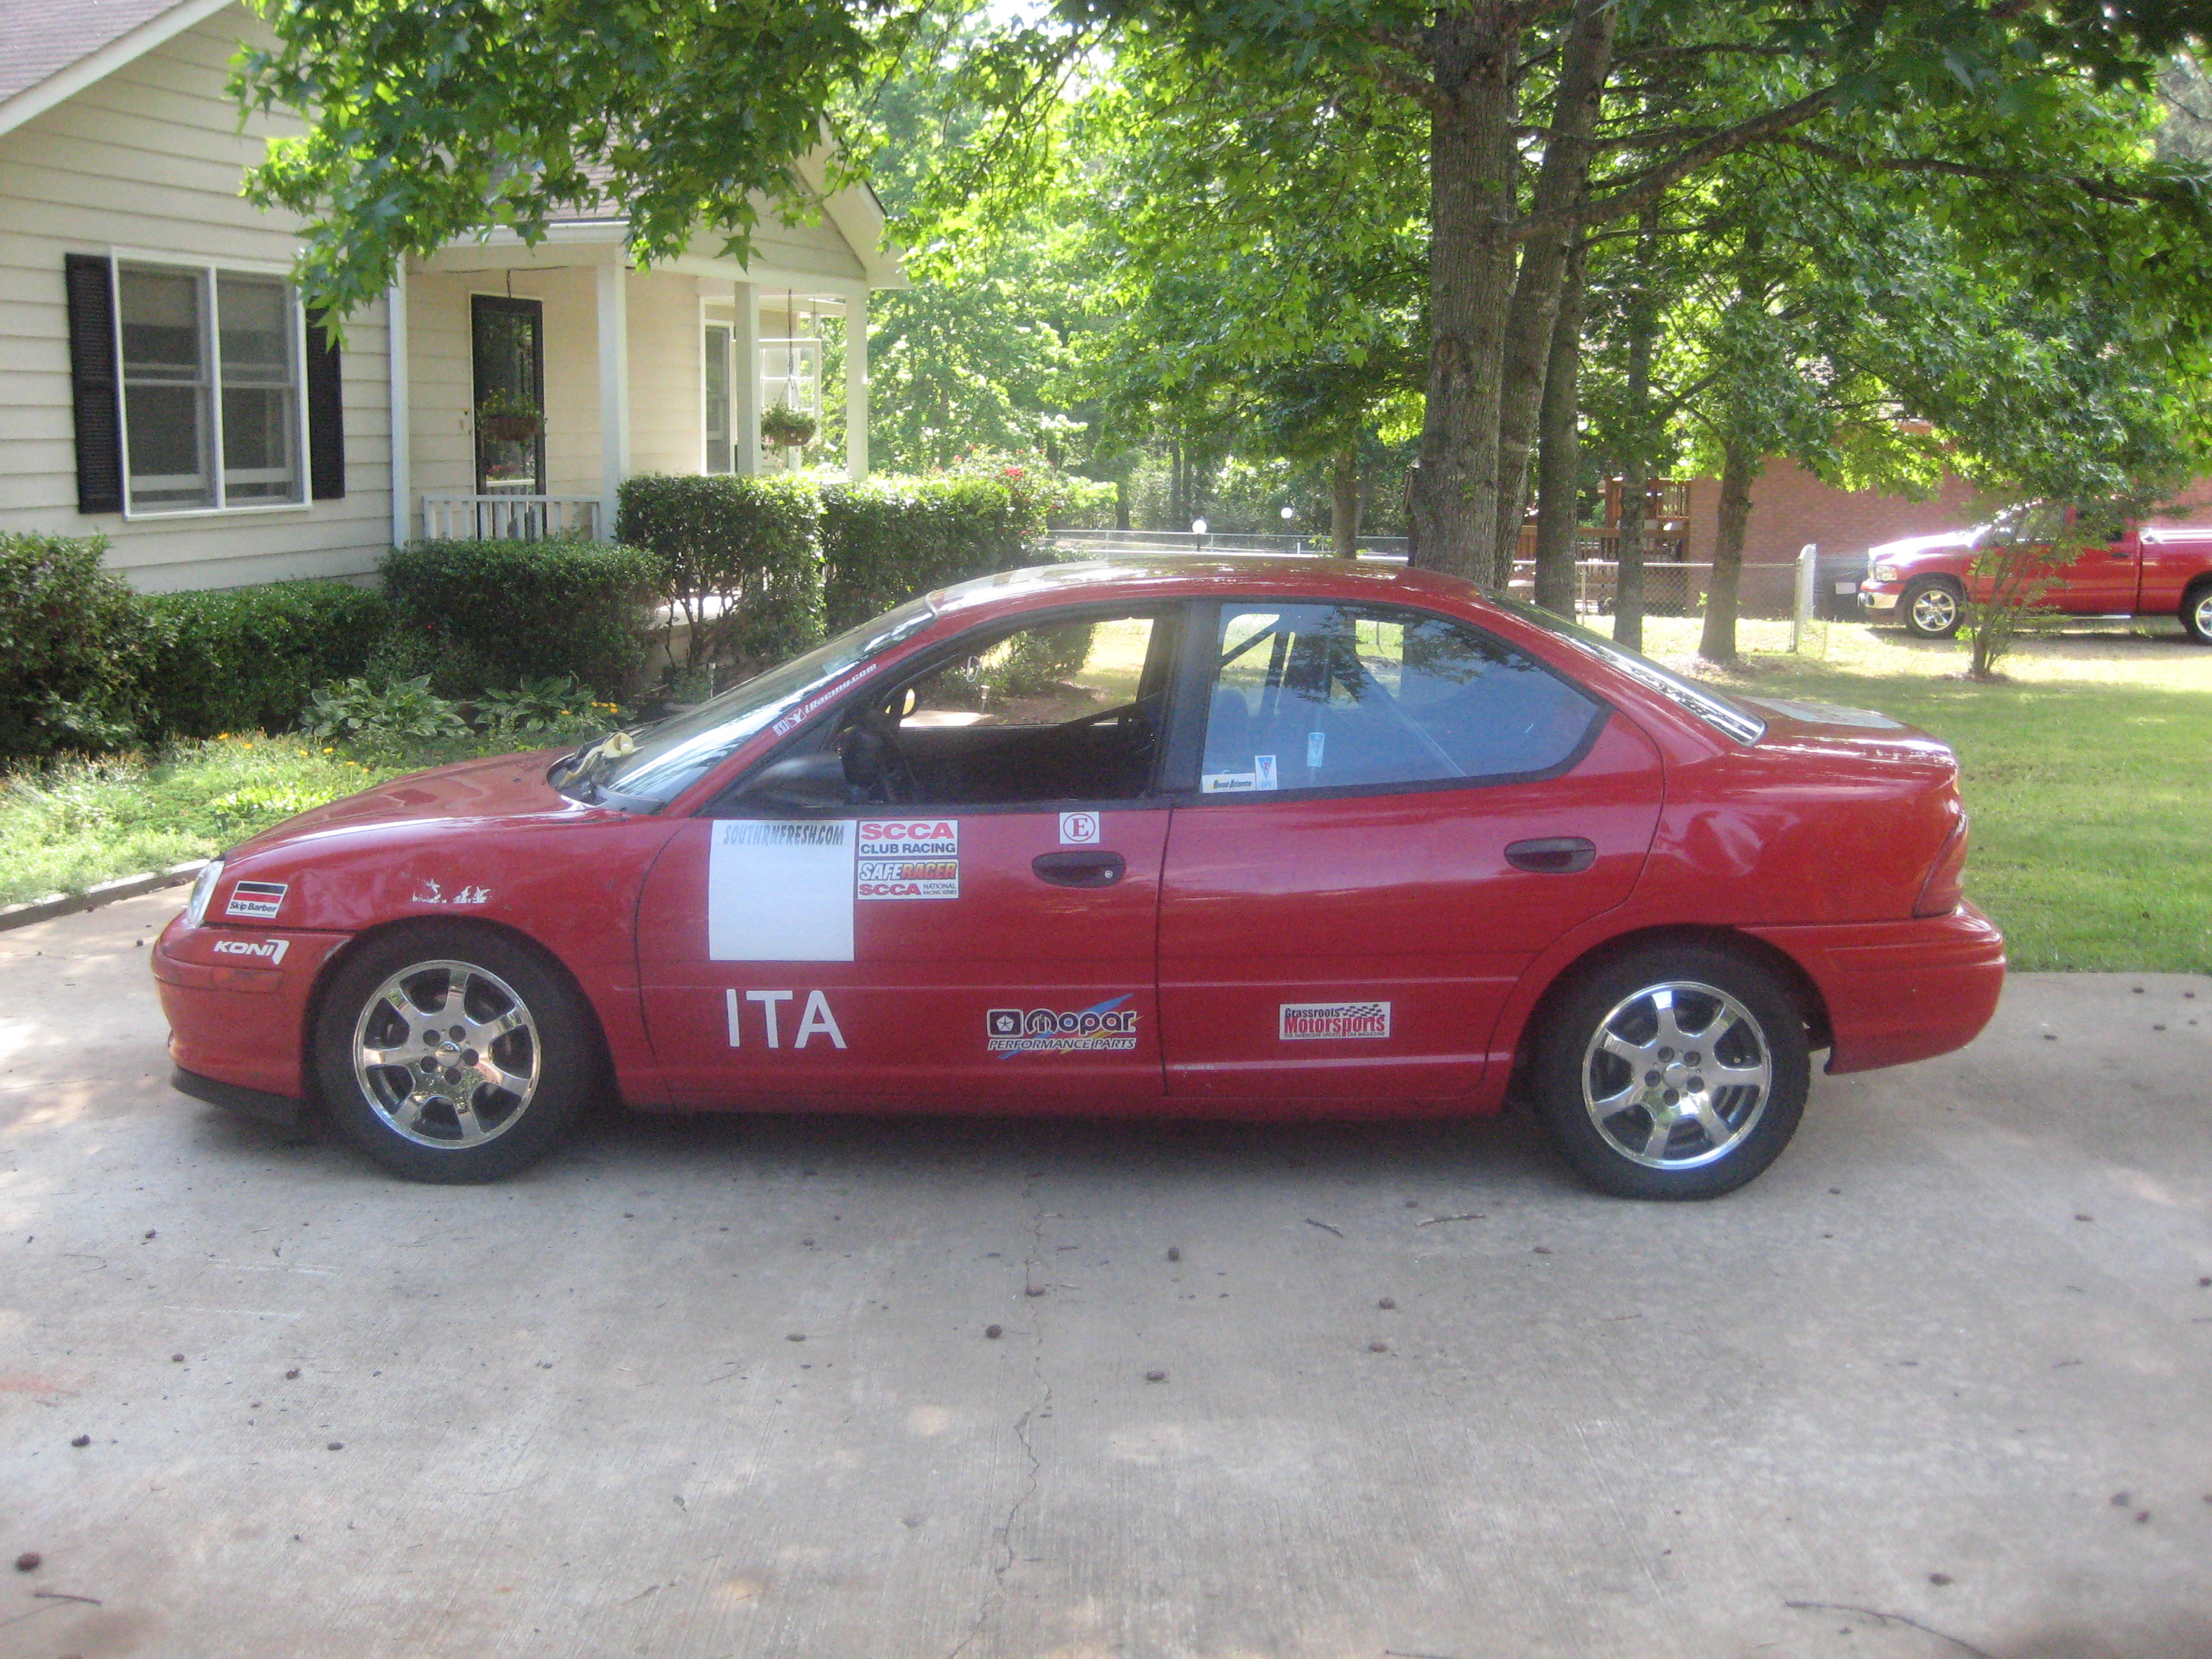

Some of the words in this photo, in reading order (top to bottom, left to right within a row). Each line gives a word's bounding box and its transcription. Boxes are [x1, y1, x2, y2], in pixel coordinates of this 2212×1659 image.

[861, 822, 955, 840] SCCA
[1071, 818, 1089, 837] E
[860, 843, 899, 854] CLUB
[902, 842, 956, 853] RACING
[859, 883, 922, 896] SCCA
[230, 902, 247, 911] Skip
[248, 903, 277, 912] Barber
[214, 940, 275, 956] KONI
[726, 989, 848, 1049] ITA
[1285, 1008, 1340, 1018] Grassroots
[1285, 1016, 1385, 1036] Motorsports
[988, 1038, 1092, 1050] PERFORMANCE
[1092, 1038, 1137, 1049] PARTS
